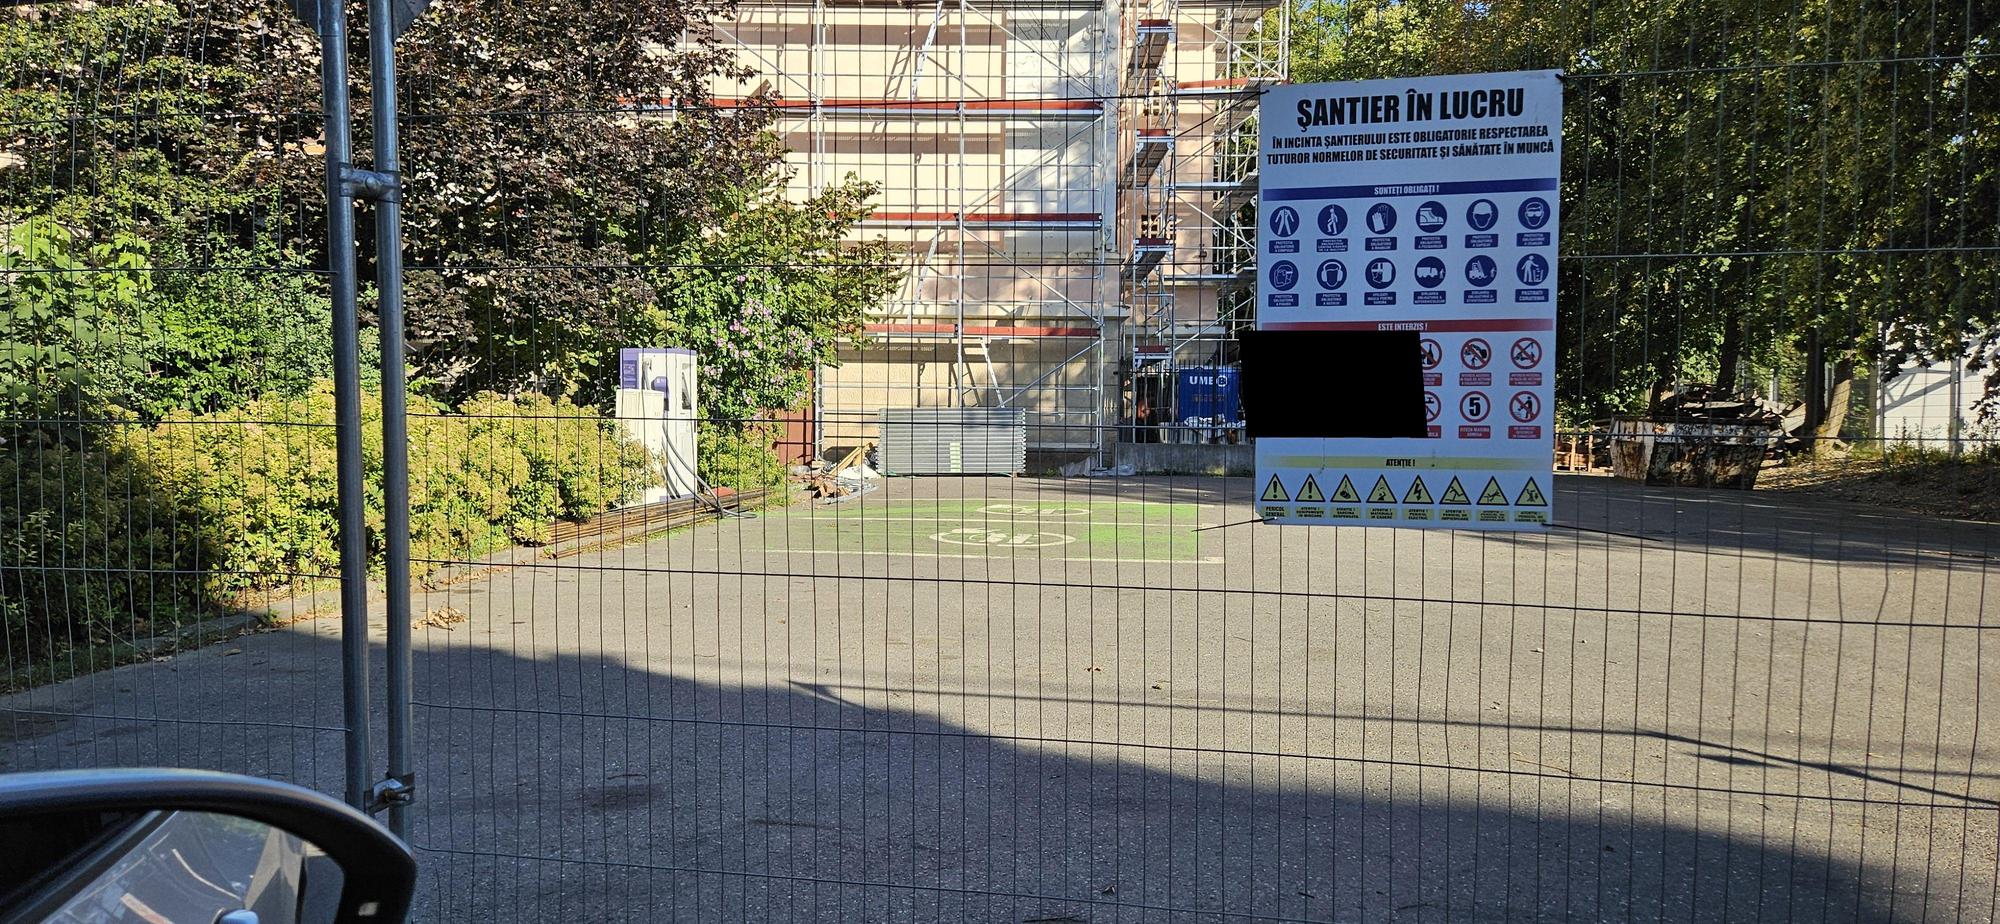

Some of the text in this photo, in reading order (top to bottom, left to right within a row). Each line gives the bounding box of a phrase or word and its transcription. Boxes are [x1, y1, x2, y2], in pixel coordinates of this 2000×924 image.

[1405, 88, 1432, 121] ÎN
[1440, 88, 1524, 120] LUCRU
[1272, 136, 1282, 149] ÎN
[1285, 136, 1322, 149] INCINTA
[1388, 131, 1411, 144] ESTE
[1413, 128, 1477, 143] OBLIGATORIE
[1479, 125, 1549, 140] RESPECTAREA
[1267, 152, 1310, 165] TUTUROR
[1312, 150, 1363, 163] NORMELOR
[1366, 149, 1378, 161] DE
[1380, 146, 1438, 160] SECURITATE
[1452, 143, 1501, 157] SĂNĂTATE
[1503, 141, 1514, 154] ÎN
[1516, 139, 1554, 154] MUNCĂ
[1378, 322, 1393, 331] ESTE
[1394, 322, 1424, 331] INTERZIS
[1469, 397, 1481, 417] 5
